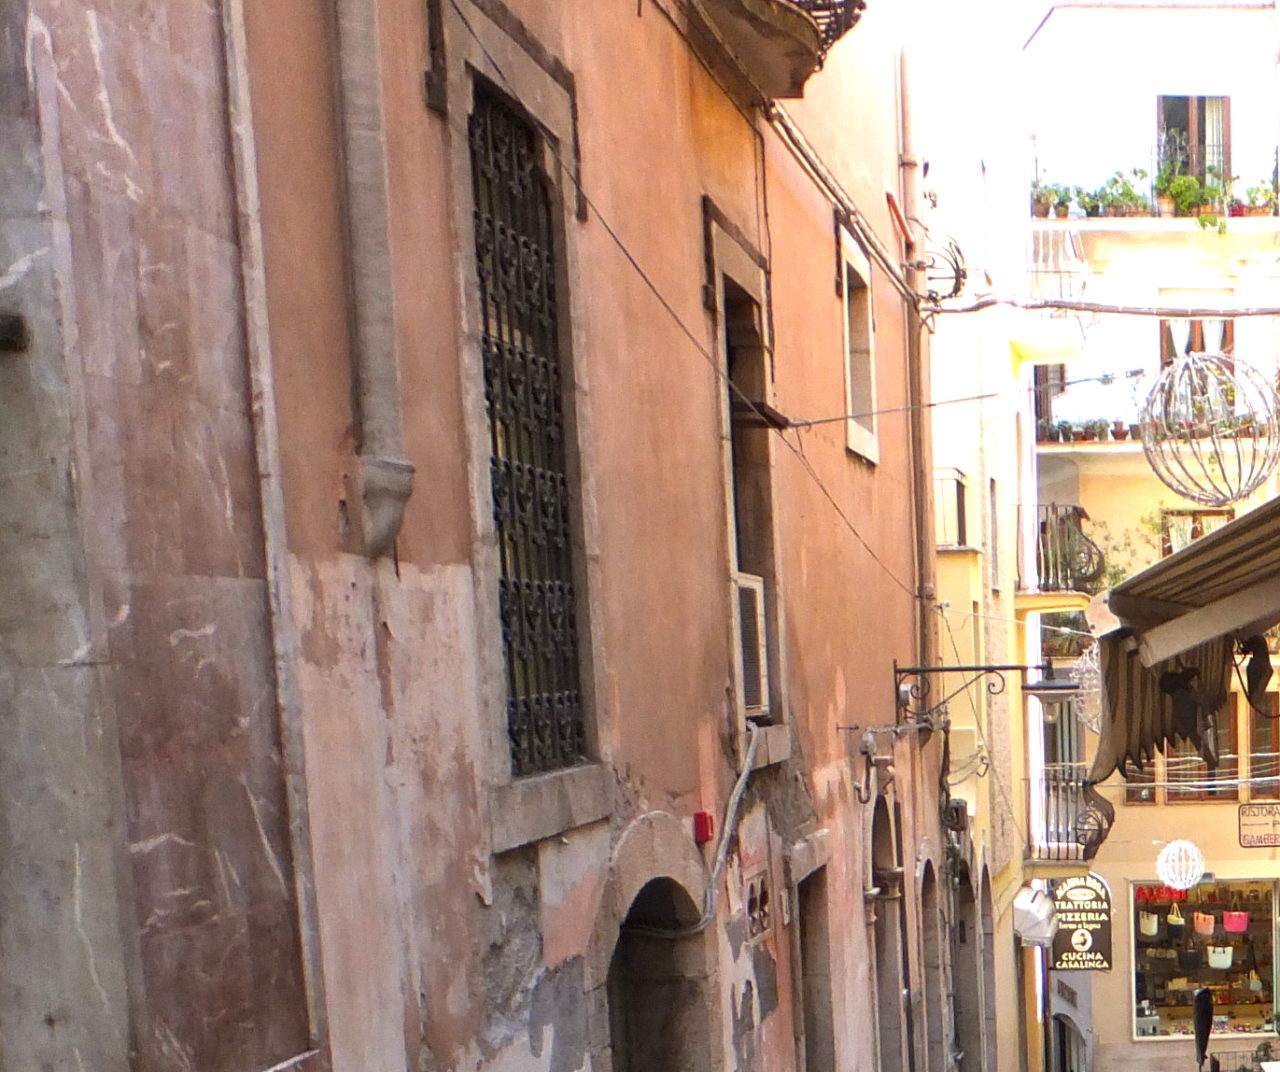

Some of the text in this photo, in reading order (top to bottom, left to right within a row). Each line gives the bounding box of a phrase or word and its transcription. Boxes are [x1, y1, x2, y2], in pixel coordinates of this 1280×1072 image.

[1054, 901, 1109, 909] TRATTORIA
[1056, 912, 1109, 921] PIZZERIA
[1062, 952, 1104, 960] CUCINA
[1056, 961, 1109, 969] CASALINGA
